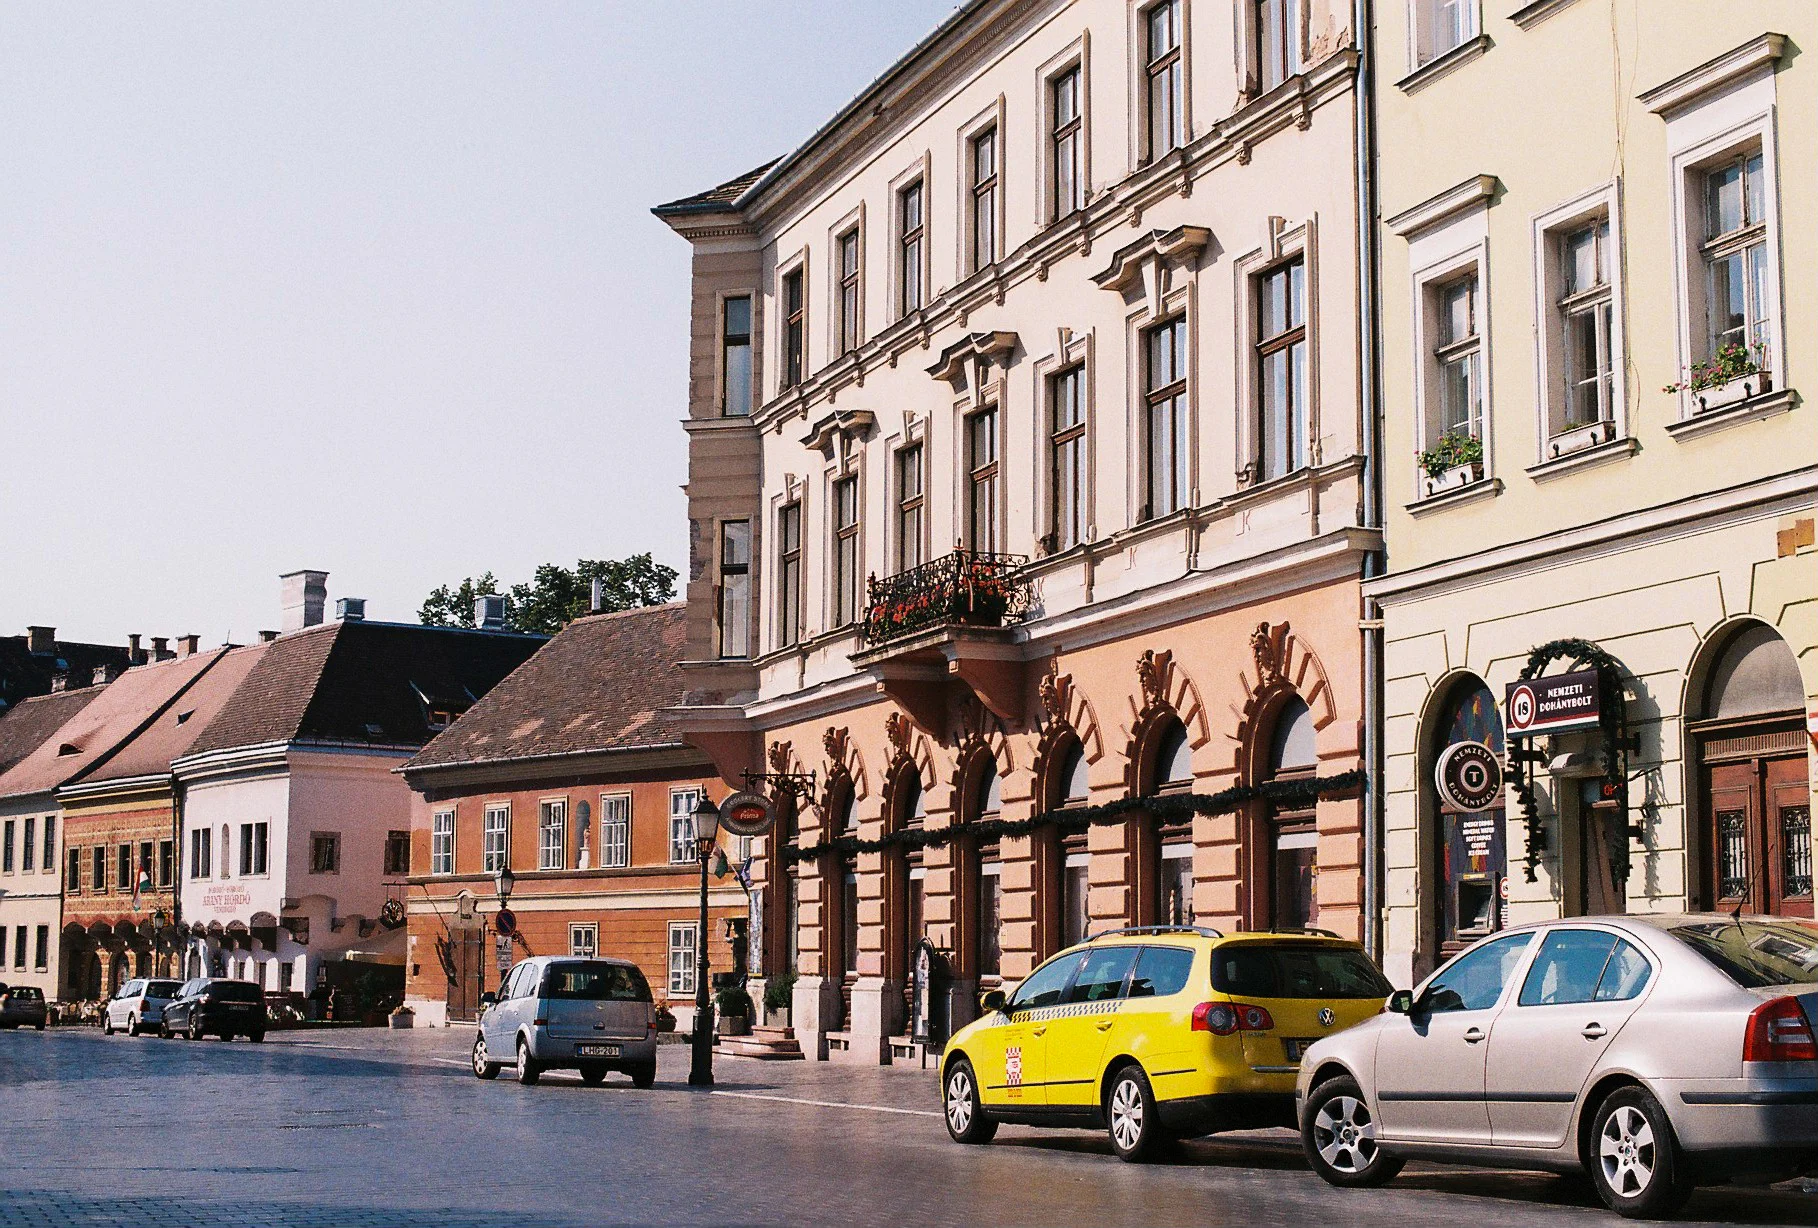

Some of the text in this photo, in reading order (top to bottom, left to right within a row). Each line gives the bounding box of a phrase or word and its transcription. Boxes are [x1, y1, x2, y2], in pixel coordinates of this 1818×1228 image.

[1547, 684, 1583, 698] NEMZETI
[1517, 701, 1529, 716] 18
[1539, 696, 1592, 713] DOHÁNYBOLT
[1454, 747, 1491, 762] NEMZETI
[1469, 771, 1480, 782] T
